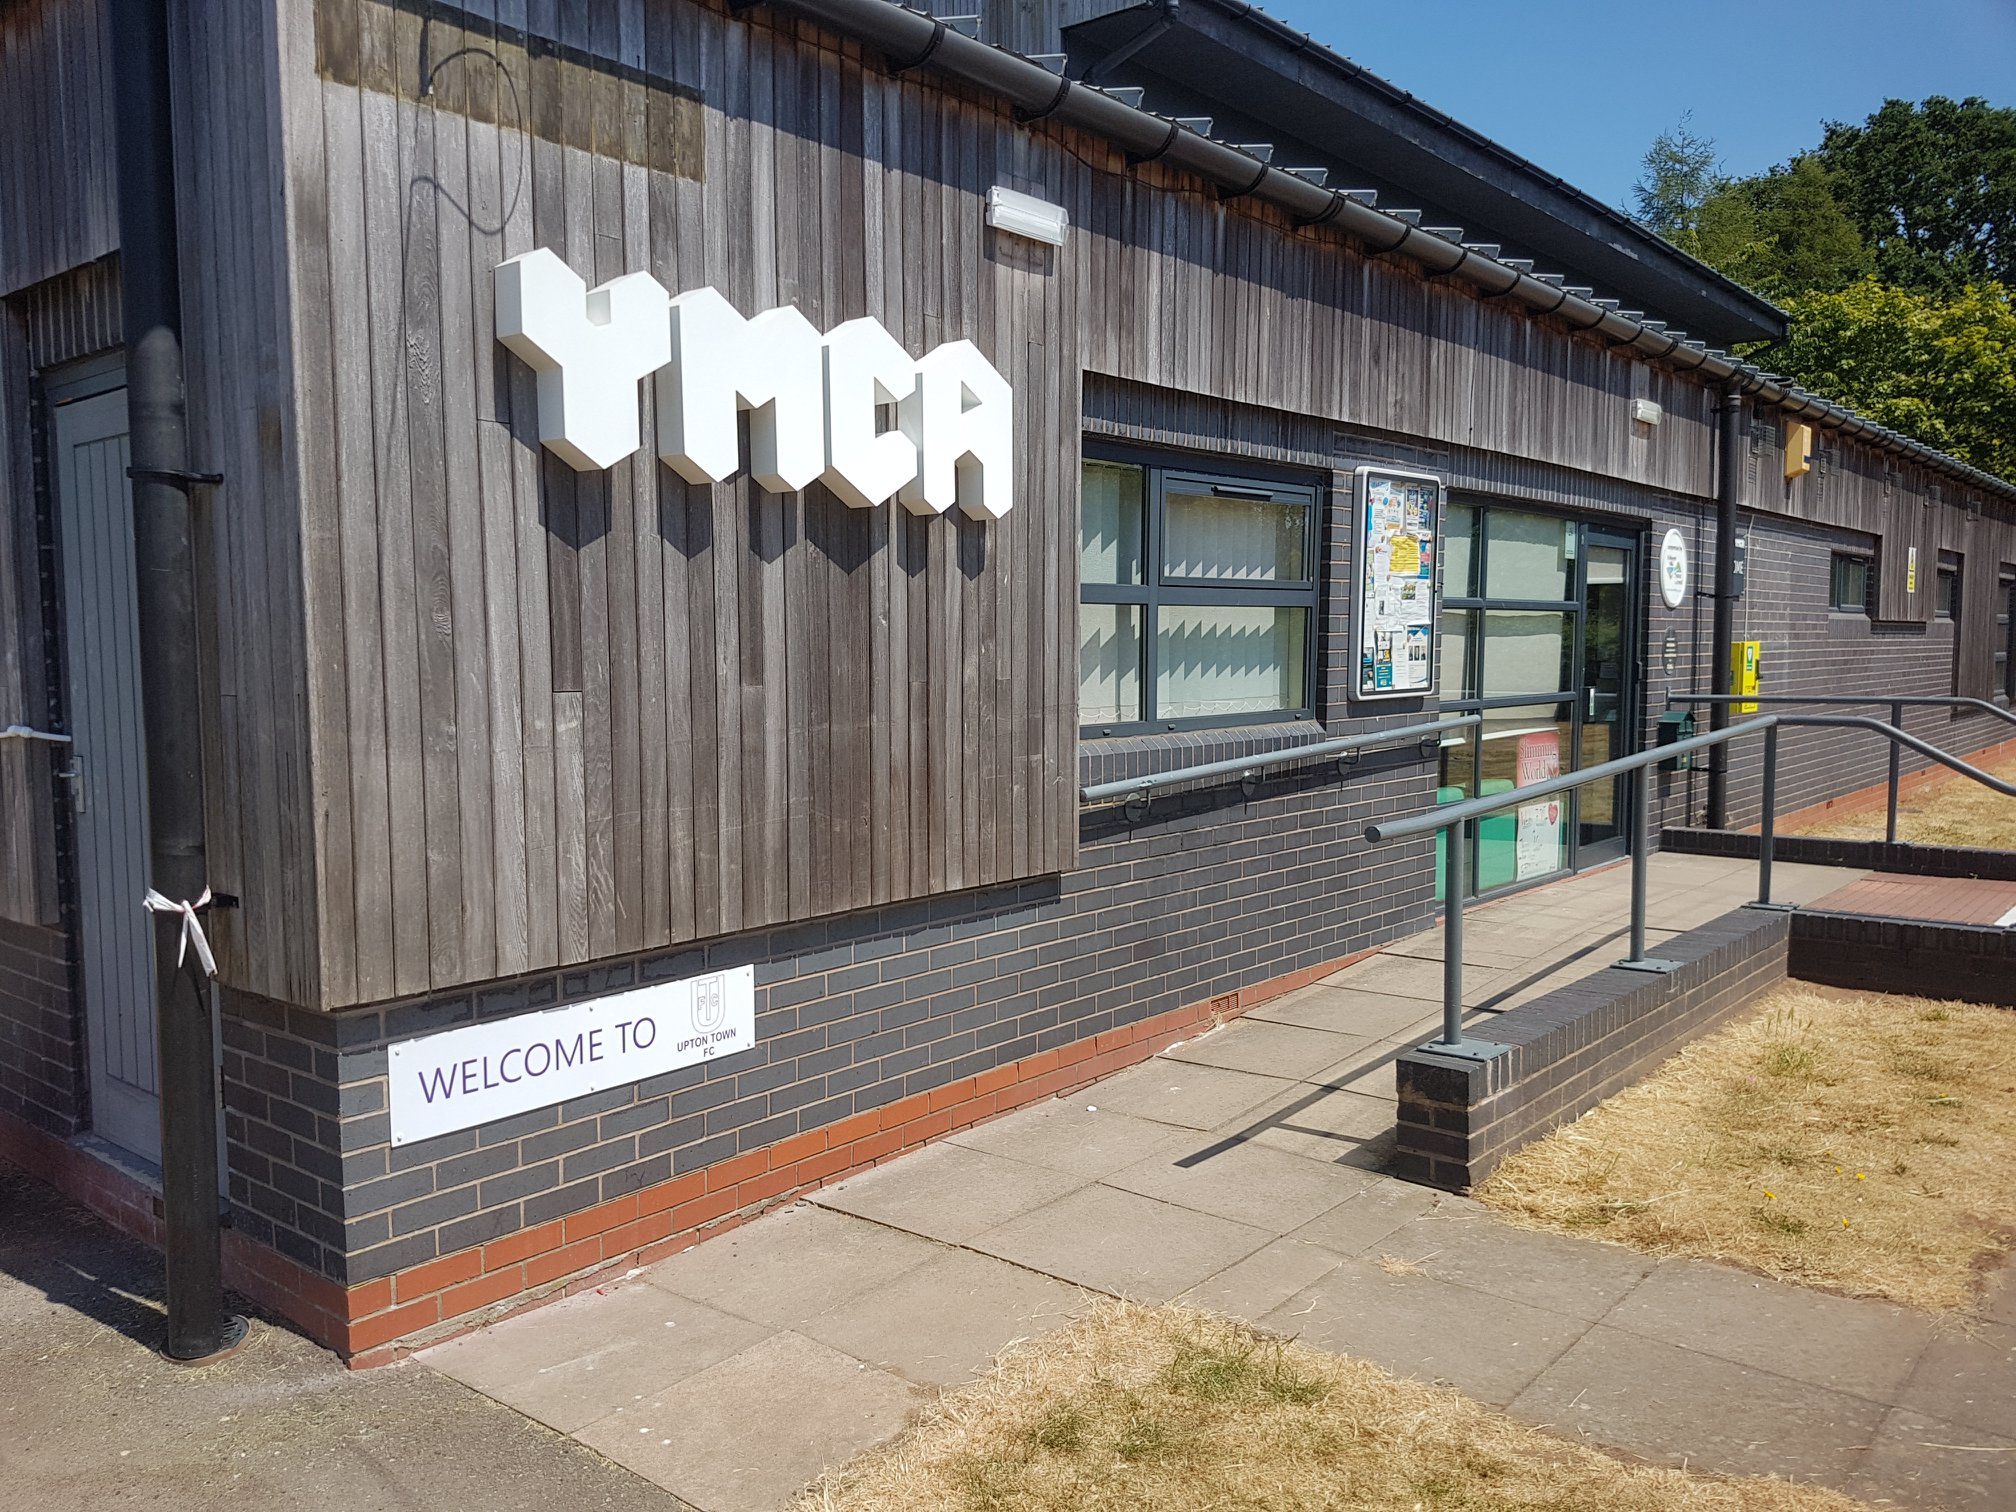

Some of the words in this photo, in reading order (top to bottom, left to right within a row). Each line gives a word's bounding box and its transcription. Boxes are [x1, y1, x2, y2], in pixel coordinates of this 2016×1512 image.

[495, 247, 1013, 521] YMCA
[1519, 739, 1557, 760] Slimming
[1521, 759, 1546, 780] World
[677, 1035, 708, 1052] UPTON
[710, 1027, 737, 1043] TOWN
[418, 1028, 604, 1104] WELCOME
[615, 1017, 656, 1054] TO
[703, 1046, 715, 1057] FC
